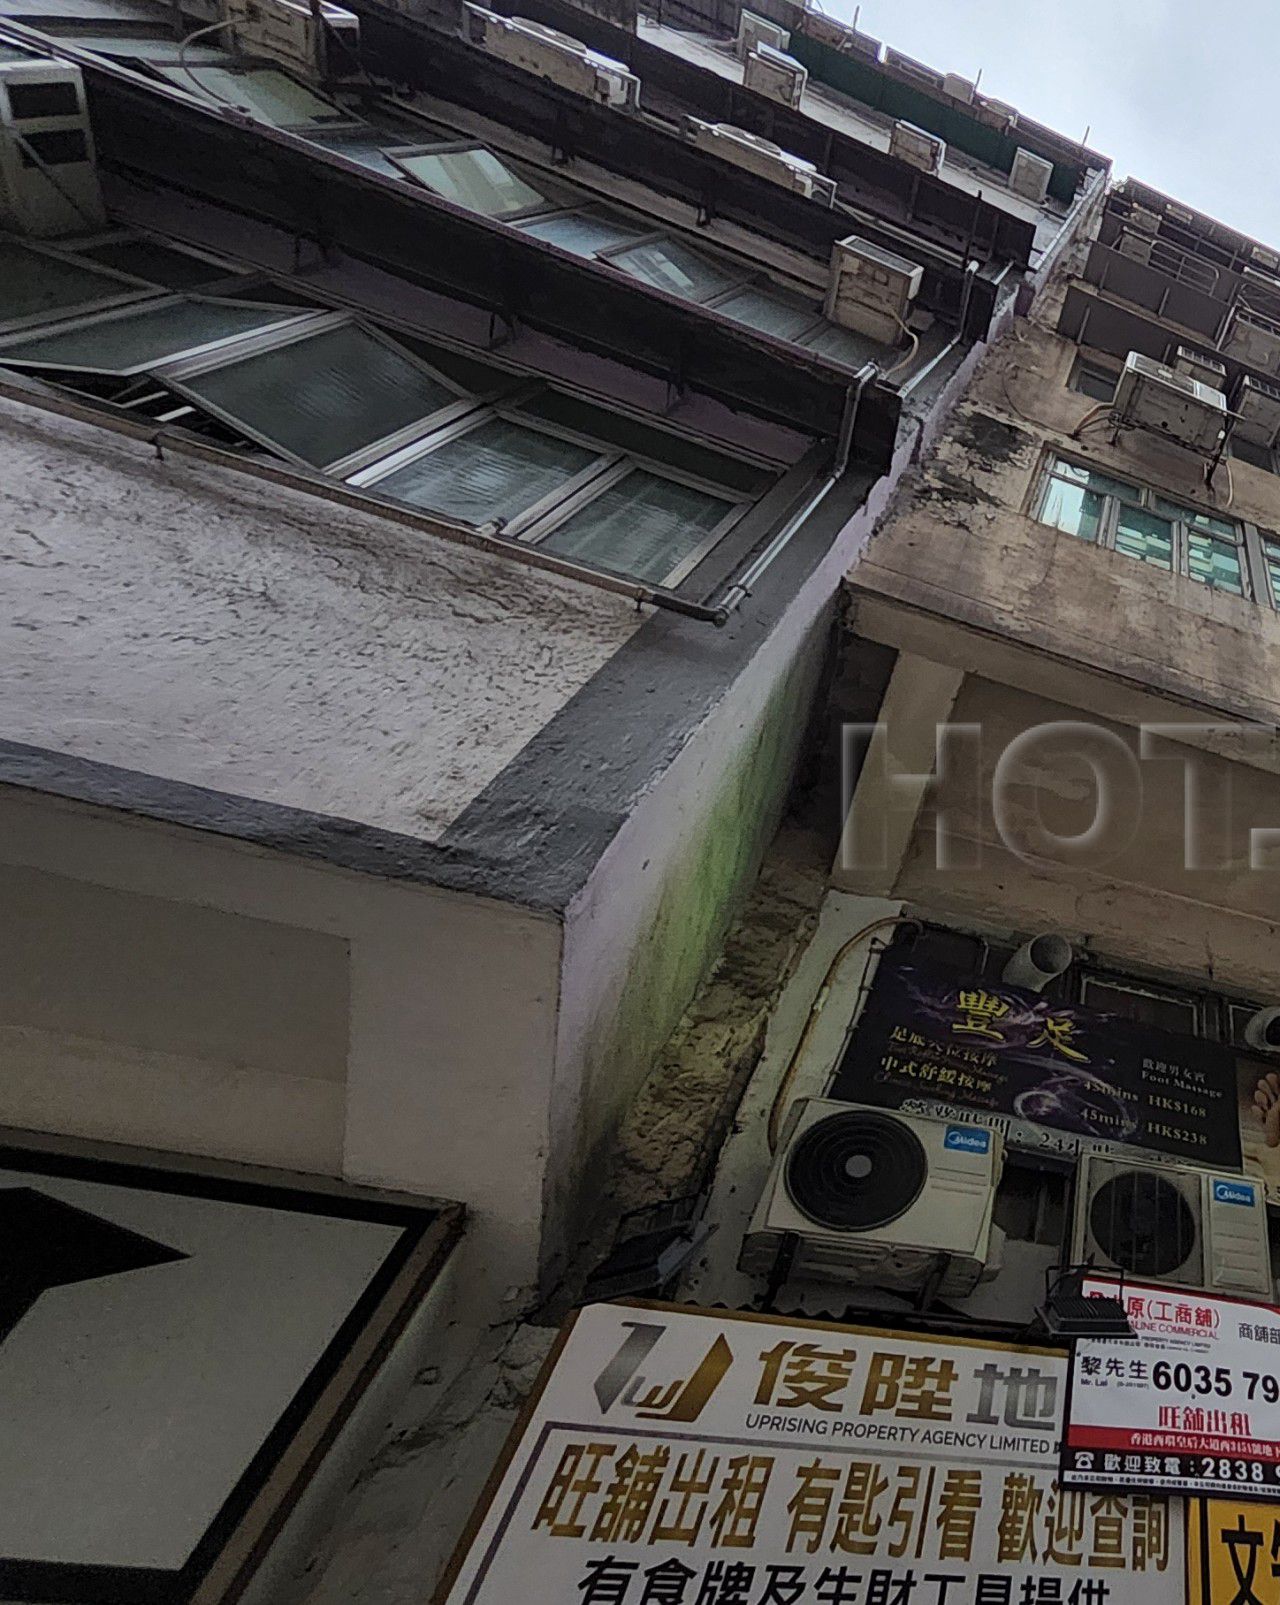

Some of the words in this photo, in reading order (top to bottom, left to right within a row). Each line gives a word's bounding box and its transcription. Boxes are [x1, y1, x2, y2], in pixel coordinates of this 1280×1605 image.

[1173, 1079, 1223, 1099] Massage
[947, 1130, 988, 1148] Midea
[1215, 1183, 1251, 1201] Midea
[1158, 1323, 1220, 1341] COMMERCIAL
[1081, 1355, 1149, 1380] 黎先生
[1152, 1360, 1232, 1398] 6035
[745, 1414, 828, 1435] UPRISING
[831, 1420, 921, 1443] PROPERTY
[921, 1430, 988, 1450] AGENCY
[990, 1433, 1050, 1454] LIMITED
[1201, 1459, 1264, 1483] 2838
[530, 1442, 775, 1549] 旺舖出租
[784, 1457, 984, 1563] 有匙引看
